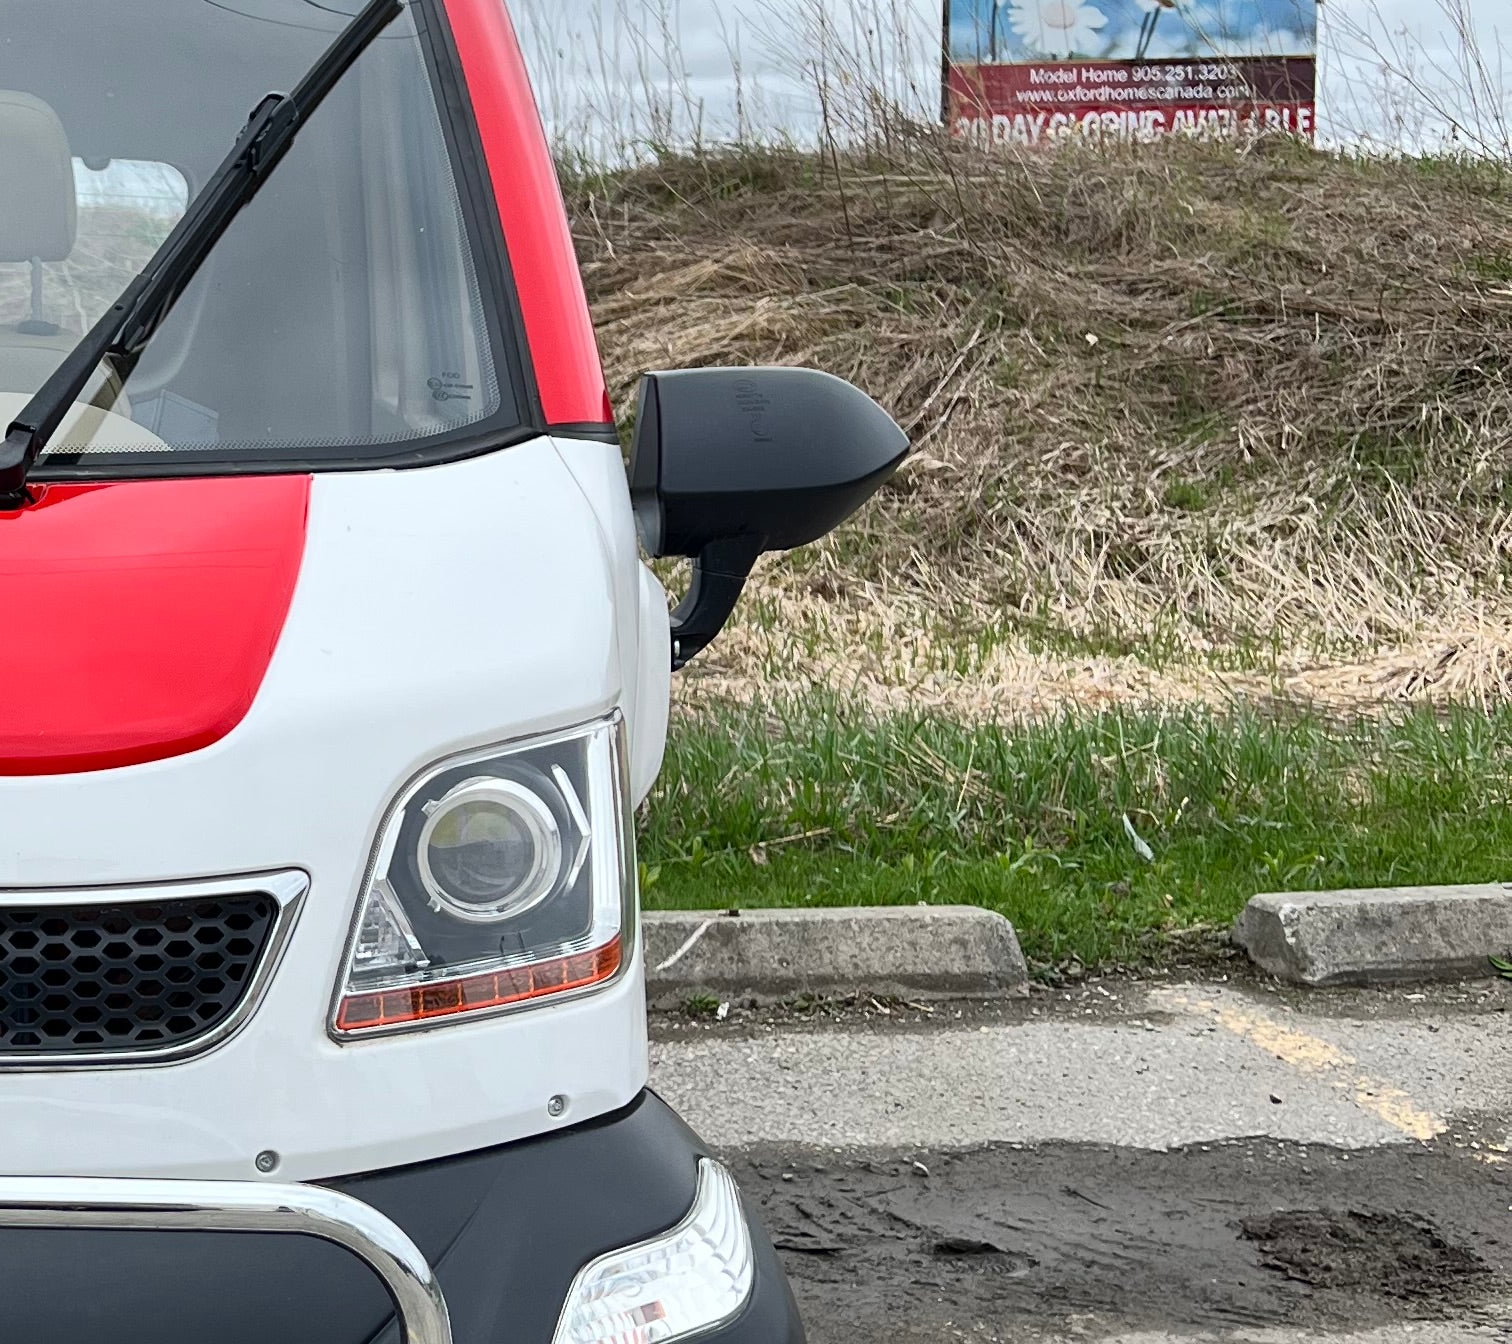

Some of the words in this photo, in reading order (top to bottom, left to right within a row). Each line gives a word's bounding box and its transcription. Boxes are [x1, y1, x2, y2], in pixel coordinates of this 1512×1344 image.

[1029, 67, 1078, 84] Model
[1081, 66, 1128, 83] Home
[1015, 83, 1252, 103] www.oxfordhomescanadacom
[992, 112, 1046, 147] DAY
